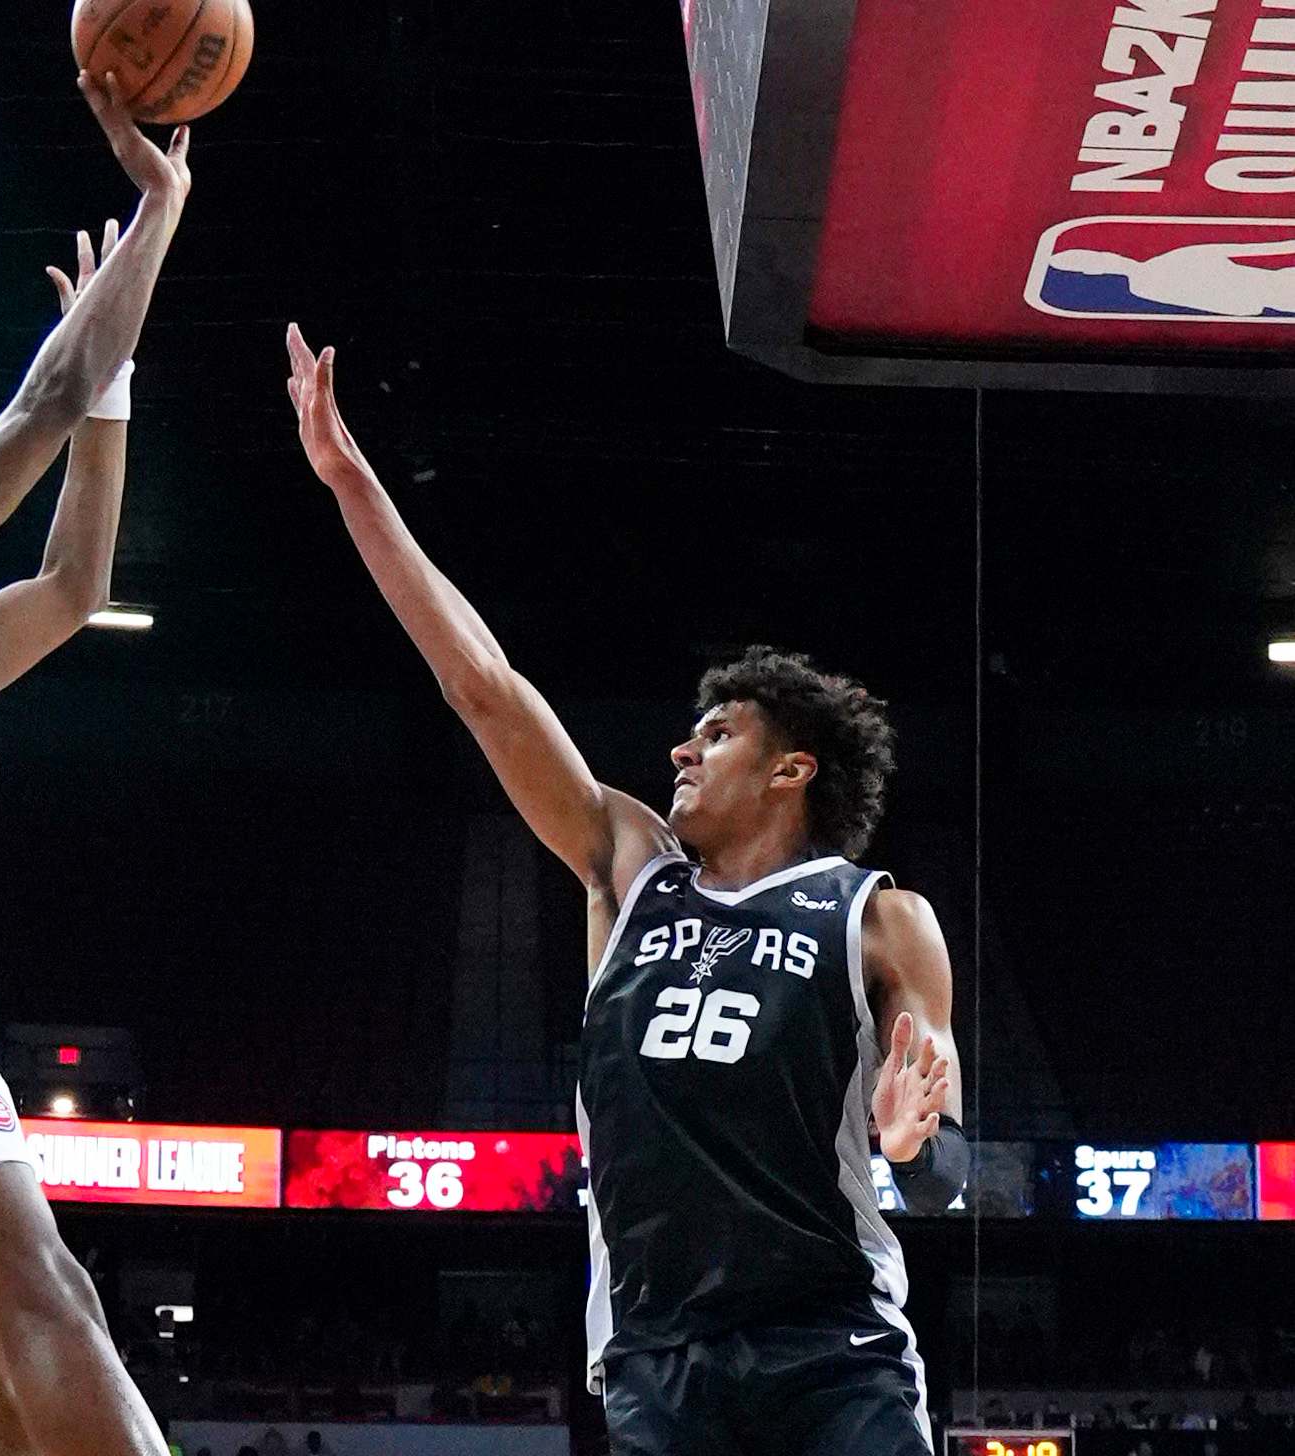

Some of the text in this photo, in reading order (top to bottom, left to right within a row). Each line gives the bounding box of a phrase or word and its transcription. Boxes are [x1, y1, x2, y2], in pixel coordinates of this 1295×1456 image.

[179, 692, 233, 723] 217
[639, 986, 760, 1064] 26
[26, 1133, 245, 1193] SUMMER LEAGUE
[367, 1135, 476, 1160] Pistons
[1075, 1145, 1156, 1174] Spurs
[387, 1161, 464, 1209] 36
[1075, 1170, 1151, 1216] 37
